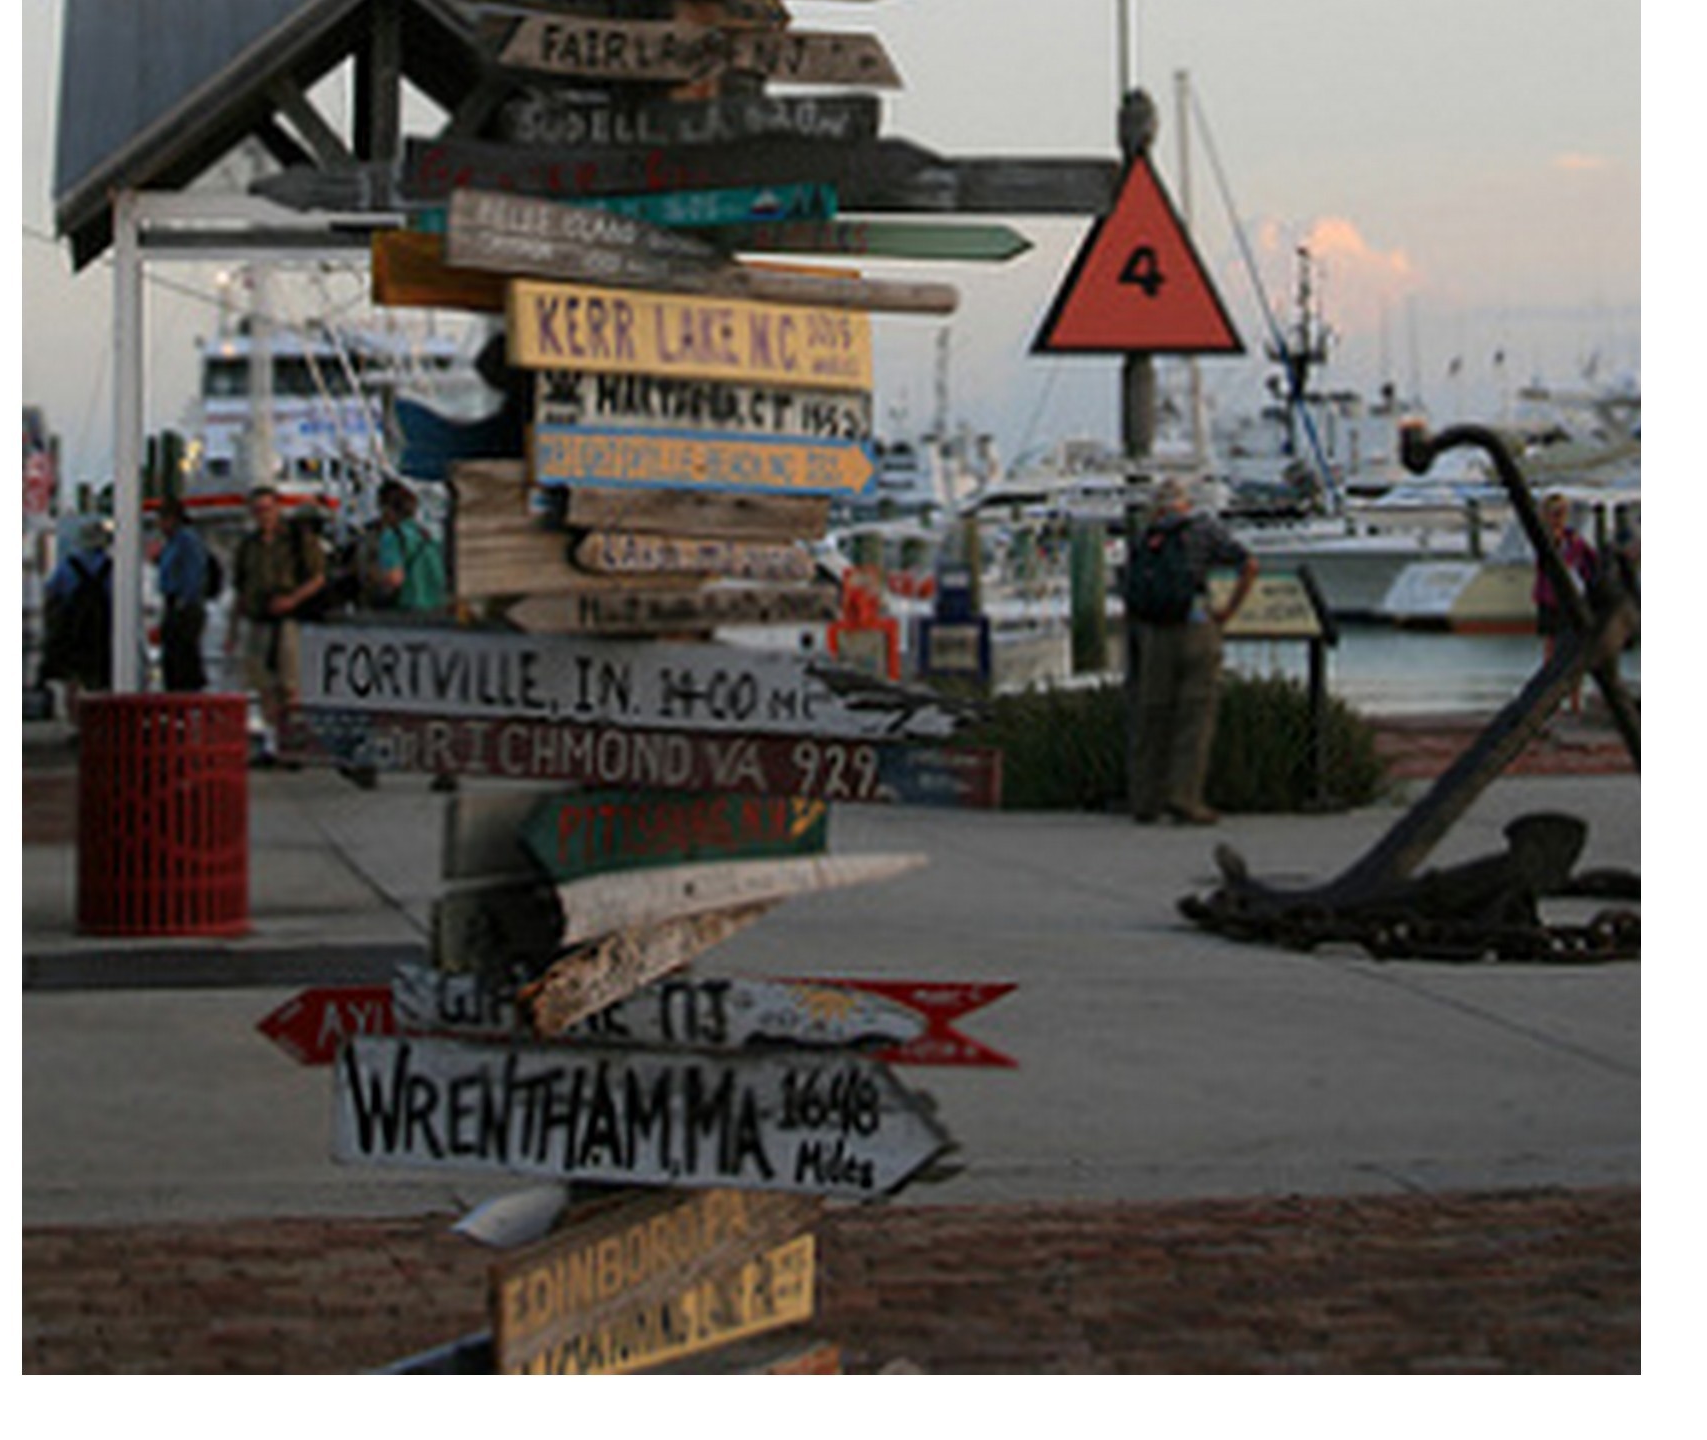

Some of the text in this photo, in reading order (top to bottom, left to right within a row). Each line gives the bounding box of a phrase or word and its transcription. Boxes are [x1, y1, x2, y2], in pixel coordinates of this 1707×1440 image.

[1117, 244, 1166, 301] 4
[538, 297, 740, 365] KERR LAKE
[321, 642, 560, 716] FORTVILLE,
